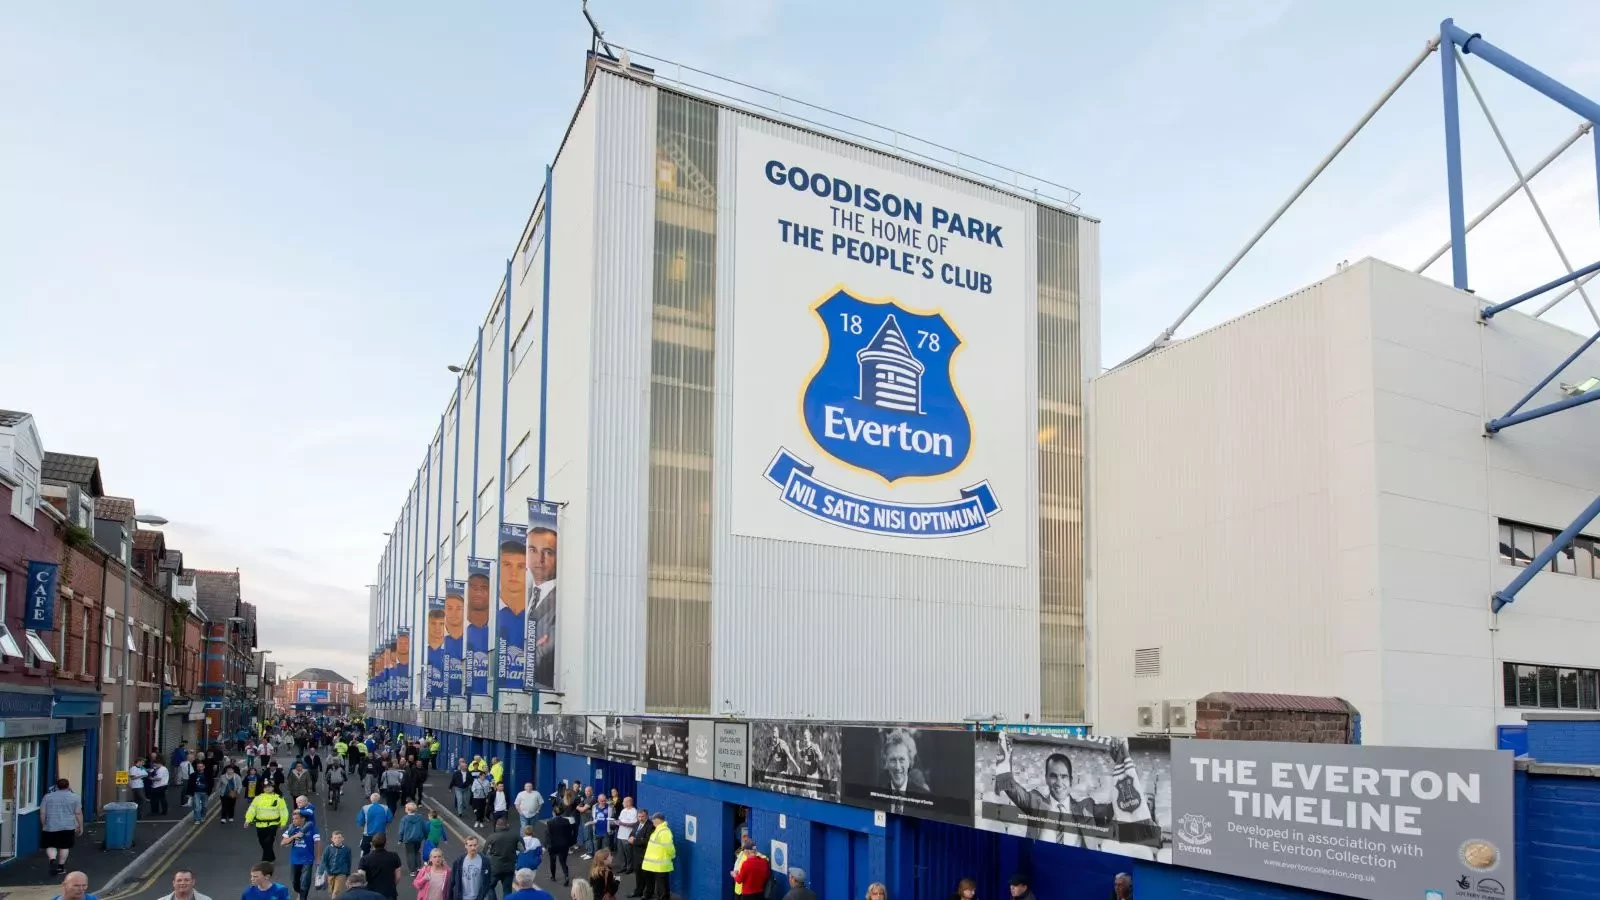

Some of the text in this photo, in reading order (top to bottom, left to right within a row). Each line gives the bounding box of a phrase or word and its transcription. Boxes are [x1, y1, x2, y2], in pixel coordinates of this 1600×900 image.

[765, 160, 1004, 248] GOODISON PARK
[830, 206, 949, 255] THE HOME OF
[778, 219, 993, 295] THE PEOPLE'S CLUB
[839, 313, 940, 352] 18 78
[824, 404, 953, 458] Everton
[789, 480, 983, 531] NIL SATIS NISI OPTIMUM
[32, 571, 48, 621] CAFE
[498, 637, 507, 678] JOHN STONES
[525, 620, 536, 687] ROBERTO MARTINEZ
[723, 769, 727, 777] 2
[1190, 757, 1480, 804] THE EVERTON
[1228, 790, 1422, 836] TIMELINE
[1178, 842, 1212, 855] Everton
[1227, 821, 1289, 840] Developed
[1293, 829, 1304, 841] in
[1308, 833, 1386, 852] association
[1387, 843, 1424, 857] with
[1248, 837, 1397, 869] The Everton Collection
